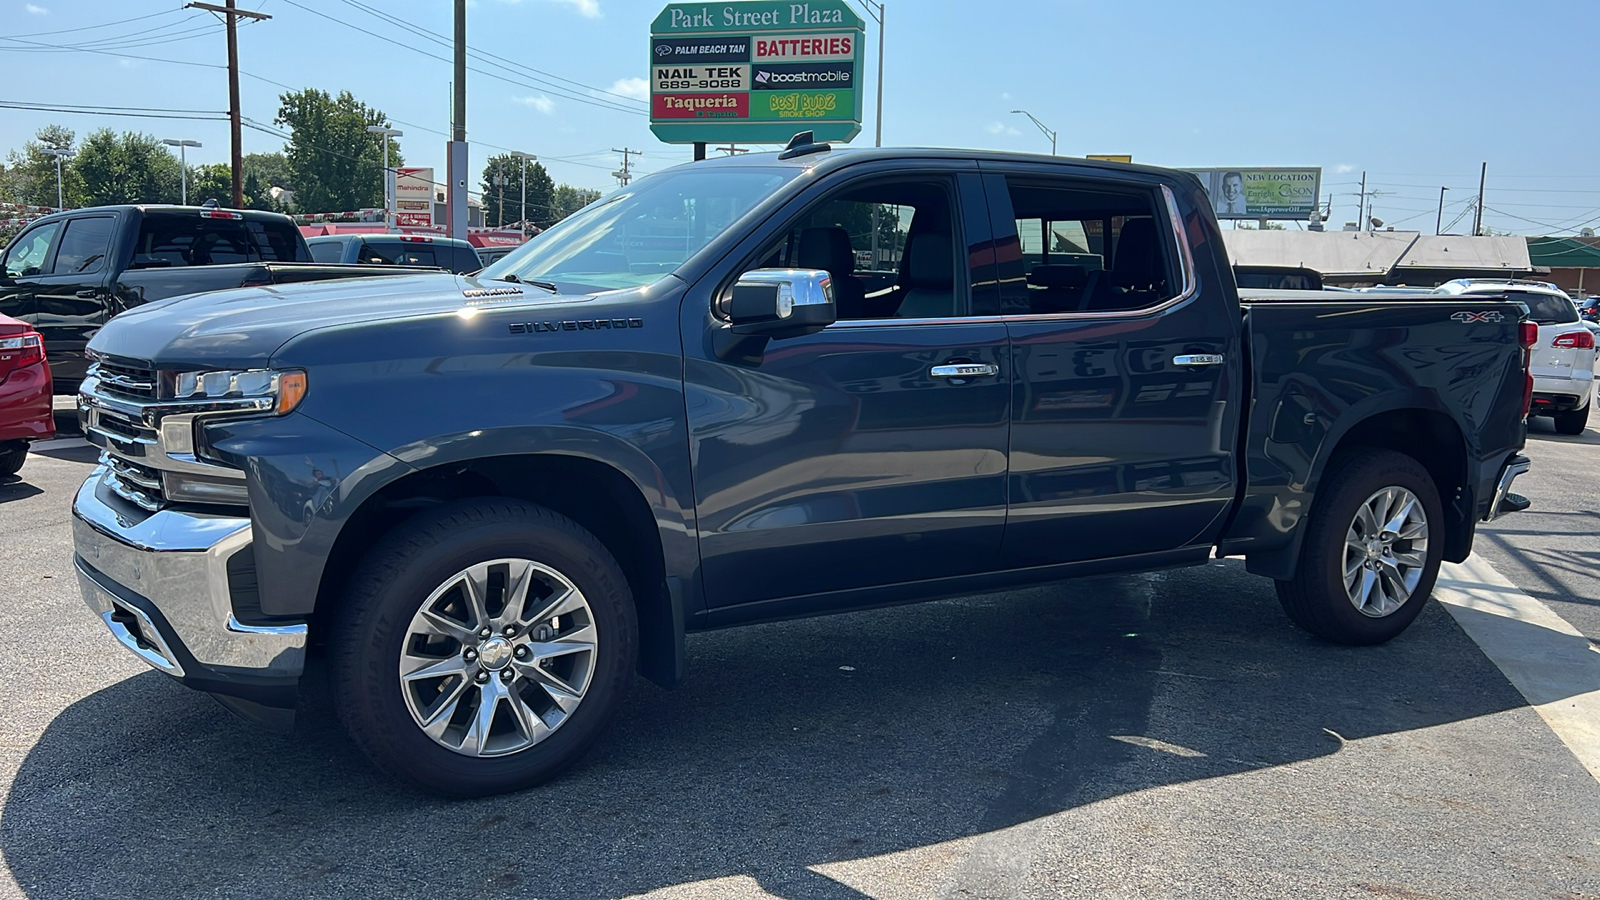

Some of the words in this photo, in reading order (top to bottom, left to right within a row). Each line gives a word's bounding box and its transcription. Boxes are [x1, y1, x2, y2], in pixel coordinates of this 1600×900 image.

[670, 7, 714, 28] Park
[722, 6, 780, 27] Street
[789, 3, 843, 24] Plaza
[674, 45, 698, 55] PALM
[698, 44, 727, 54] BEACH
[728, 44, 746, 54] TAN
[756, 37, 852, 57] BATTERIES
[657, 68, 698, 79] NAIL
[704, 67, 742, 78] TEK
[771, 70, 851, 83] boostmobile
[659, 79, 741, 89] 689-9088
[778, 110, 804, 118] SMOKE
[804, 110, 826, 118] SHOP
[1247, 190, 1275, 198] Enright
[1278, 183, 1314, 197] CASON
[508, 317, 644, 334] SILVERADO
